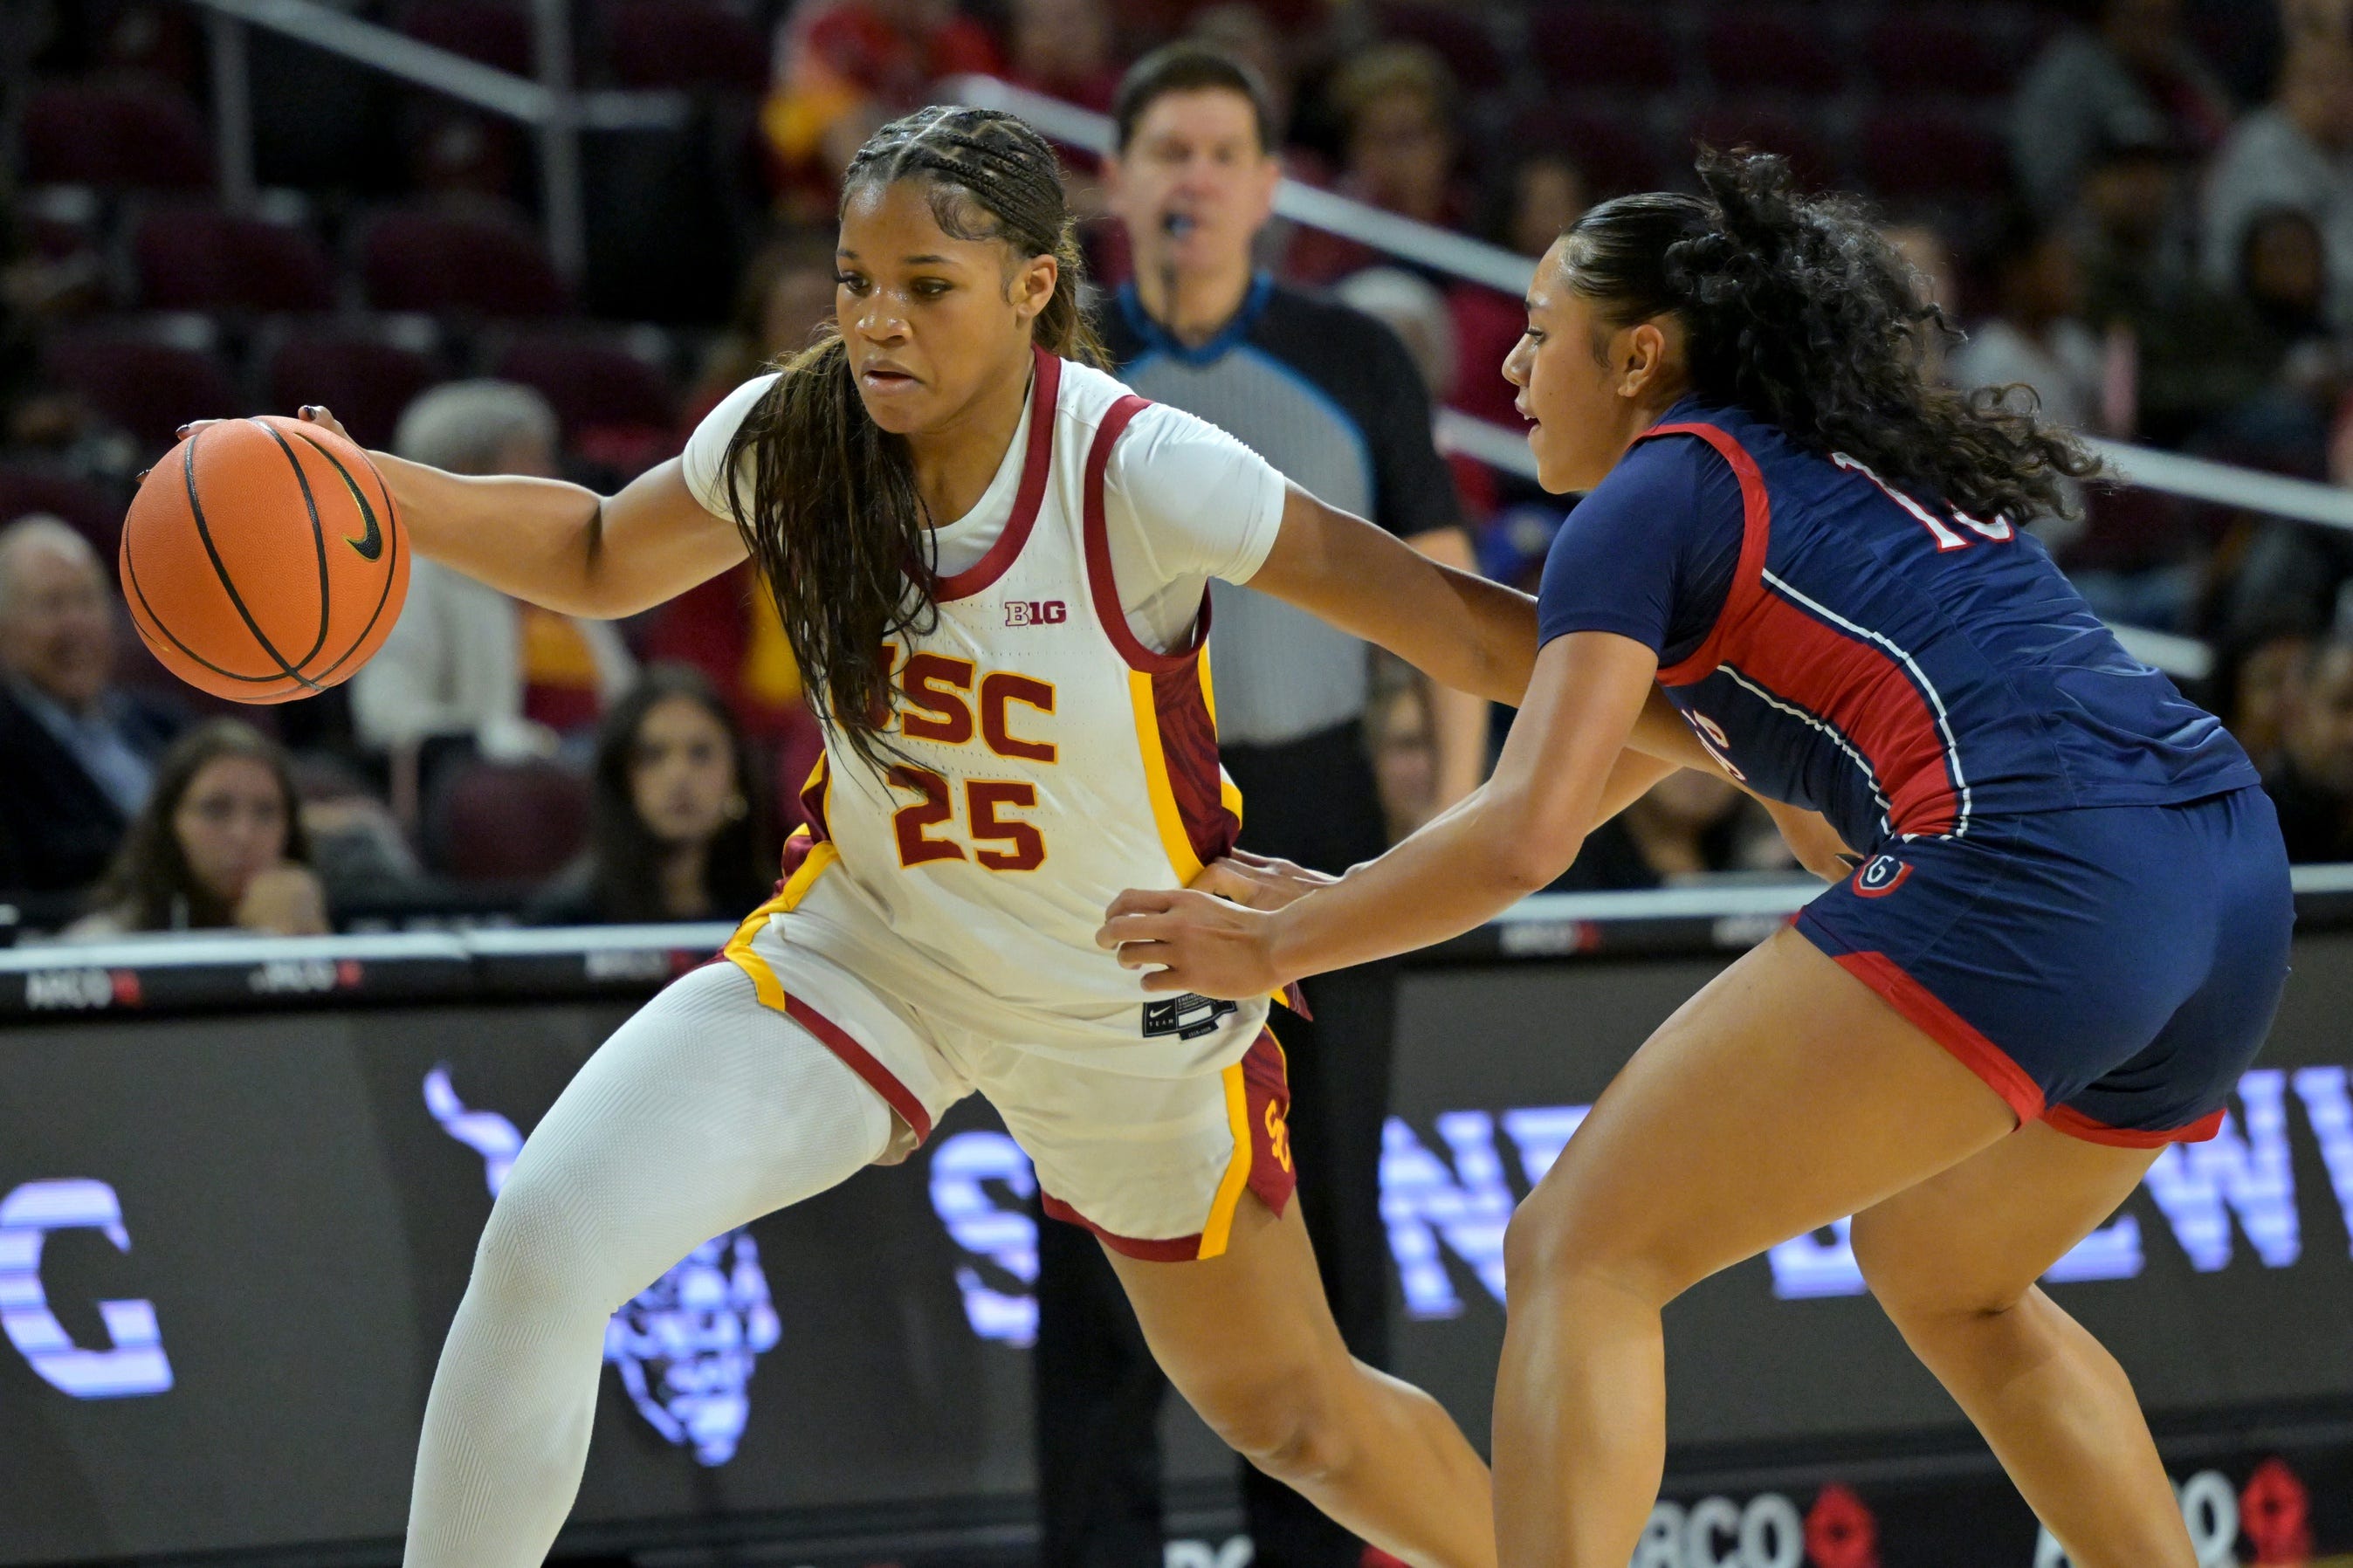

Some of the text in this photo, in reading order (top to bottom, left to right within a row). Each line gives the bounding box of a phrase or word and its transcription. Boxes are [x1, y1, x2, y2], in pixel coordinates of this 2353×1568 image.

[885, 761, 1048, 873] 25
[1867, 855, 1895, 884] G
[1149, 1018, 1173, 1027] TEAM
